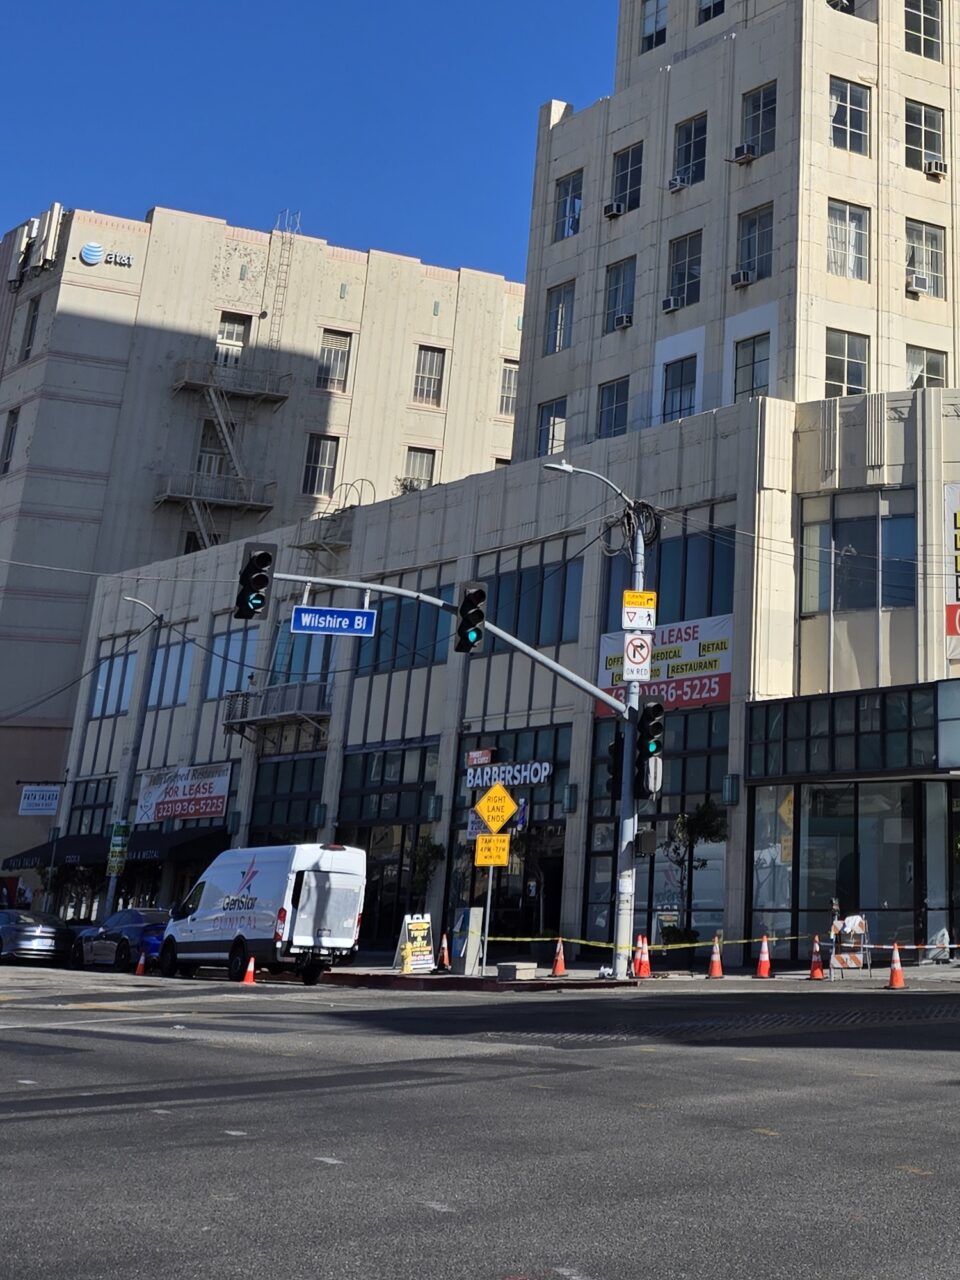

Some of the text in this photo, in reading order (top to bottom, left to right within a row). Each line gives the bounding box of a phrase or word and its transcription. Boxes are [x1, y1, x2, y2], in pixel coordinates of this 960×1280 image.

[301, 613, 367, 630] Wilshire Bl
[661, 625, 700, 646] LEASE
[702, 641, 729, 654] RETAIL
[608, 656, 624, 668] OFFI
[670, 659, 718, 675] RESTAURANT
[626, 667, 636, 676] ON
[637, 667, 649, 676] RED
[466, 762, 550, 788] BARBERSHOP
[164, 782, 214, 798] FOR LEASE
[486, 796, 507, 804] RIGHT
[486, 805, 505, 814] LANE
[486, 815, 505, 823] ENDS
[222, 894, 258, 912] GenStar
